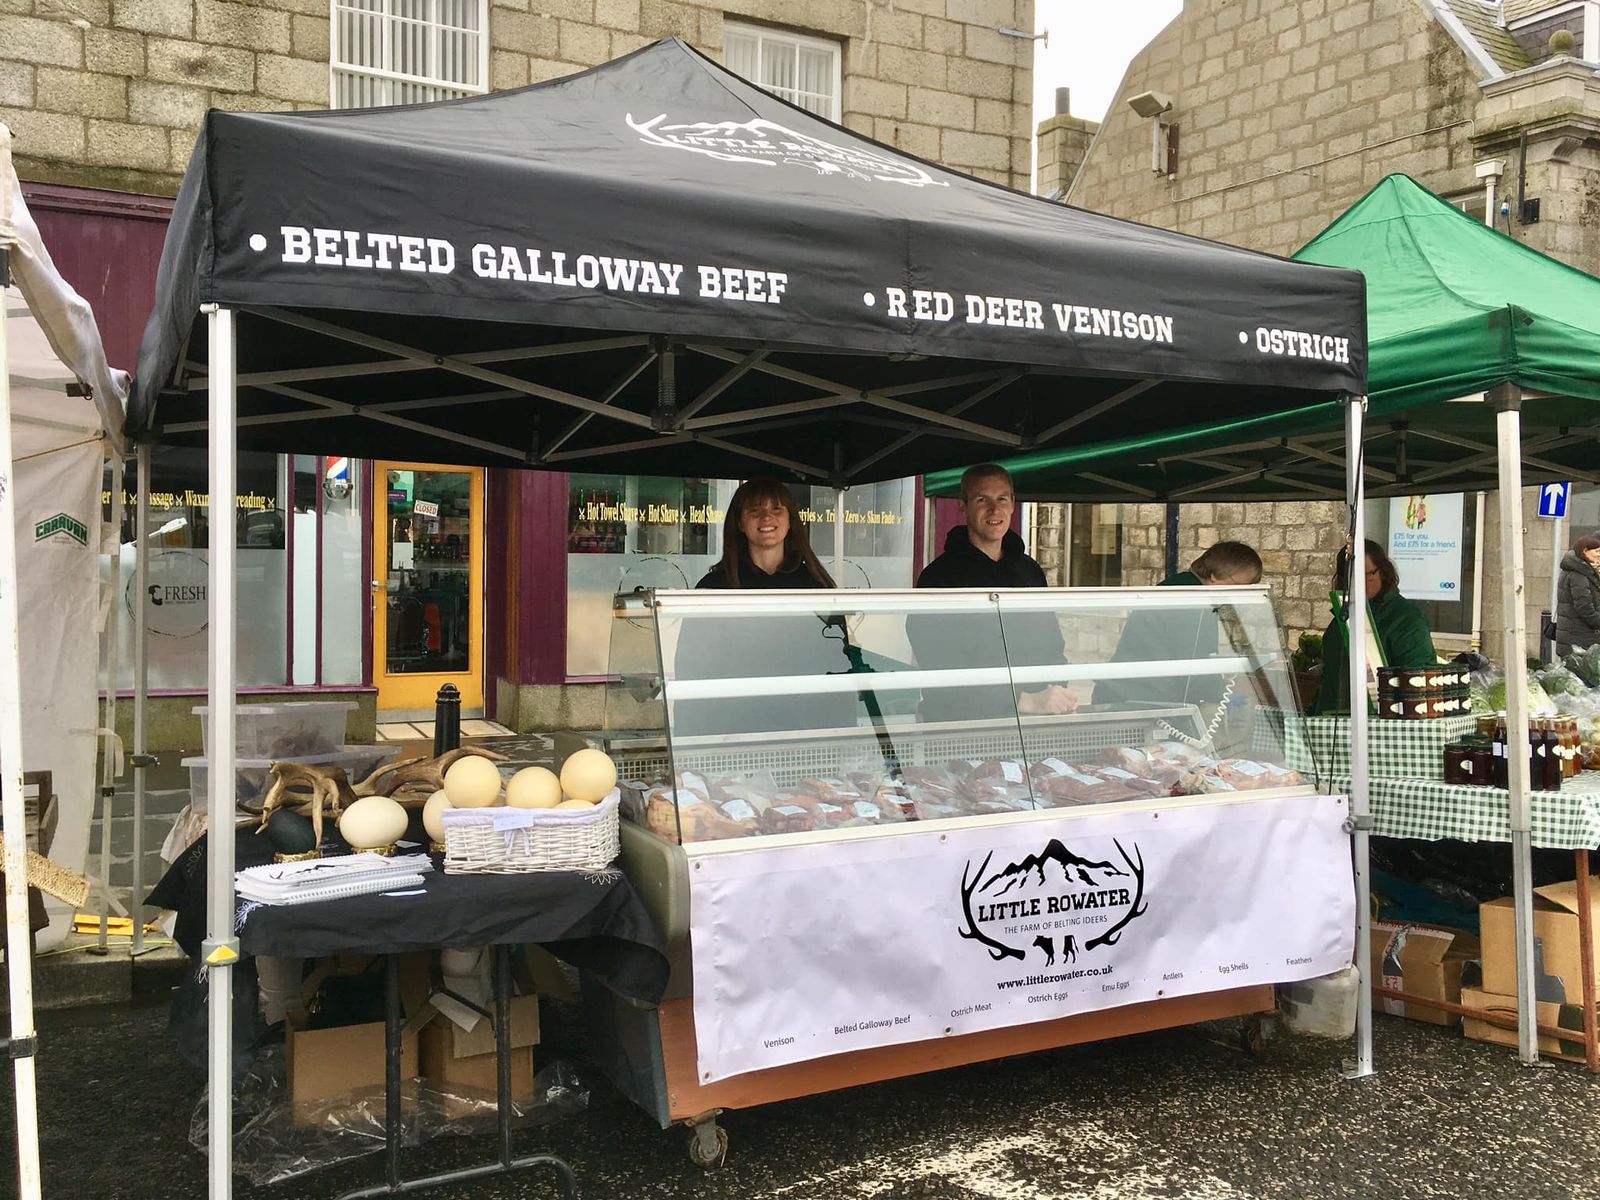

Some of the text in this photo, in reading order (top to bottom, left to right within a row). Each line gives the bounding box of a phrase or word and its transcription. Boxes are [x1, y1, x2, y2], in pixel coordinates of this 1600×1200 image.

[665, 134, 777, 150] LITTLE
[280, 225, 788, 304] BELTED GALLOWAY BEEF
[886, 287, 1174, 343] RED DEER VENISON
[1256, 327, 1350, 364] OSTRICH
[184, 489, 210, 507] Waxin
[235, 490, 266, 513] reading
[415, 504, 437, 515] CLOSED
[586, 501, 639, 523] Hot Towel Shave
[648, 504, 679, 523] Hot Shave
[689, 504, 706, 524] Head
[845, 510, 860, 524] Zero
[867, 510, 895, 525] Skin Fade
[35, 515, 88, 543] CARAVAN
[165, 586, 206, 601] FRESH
[978, 888, 1131, 923] LITTLE ROWATER
[1004, 915, 1108, 934] THE FARM OF BELTING IDEERS
[1218, 962, 1249, 975] Egg Shells
[1286, 956, 1312, 966] Feathers
[997, 965, 1114, 991] www.littlerowater.co.uk
[1162, 971, 1184, 981] Antlers
[1101, 980, 1130, 992] Emu Eggs
[1027, 991, 1069, 1004] Ostrich Eggs
[950, 1002, 992, 1018] Ostrich Meat
[834, 1014, 911, 1035] Belted Galloway Beef
[763, 1036, 795, 1049] Venison
